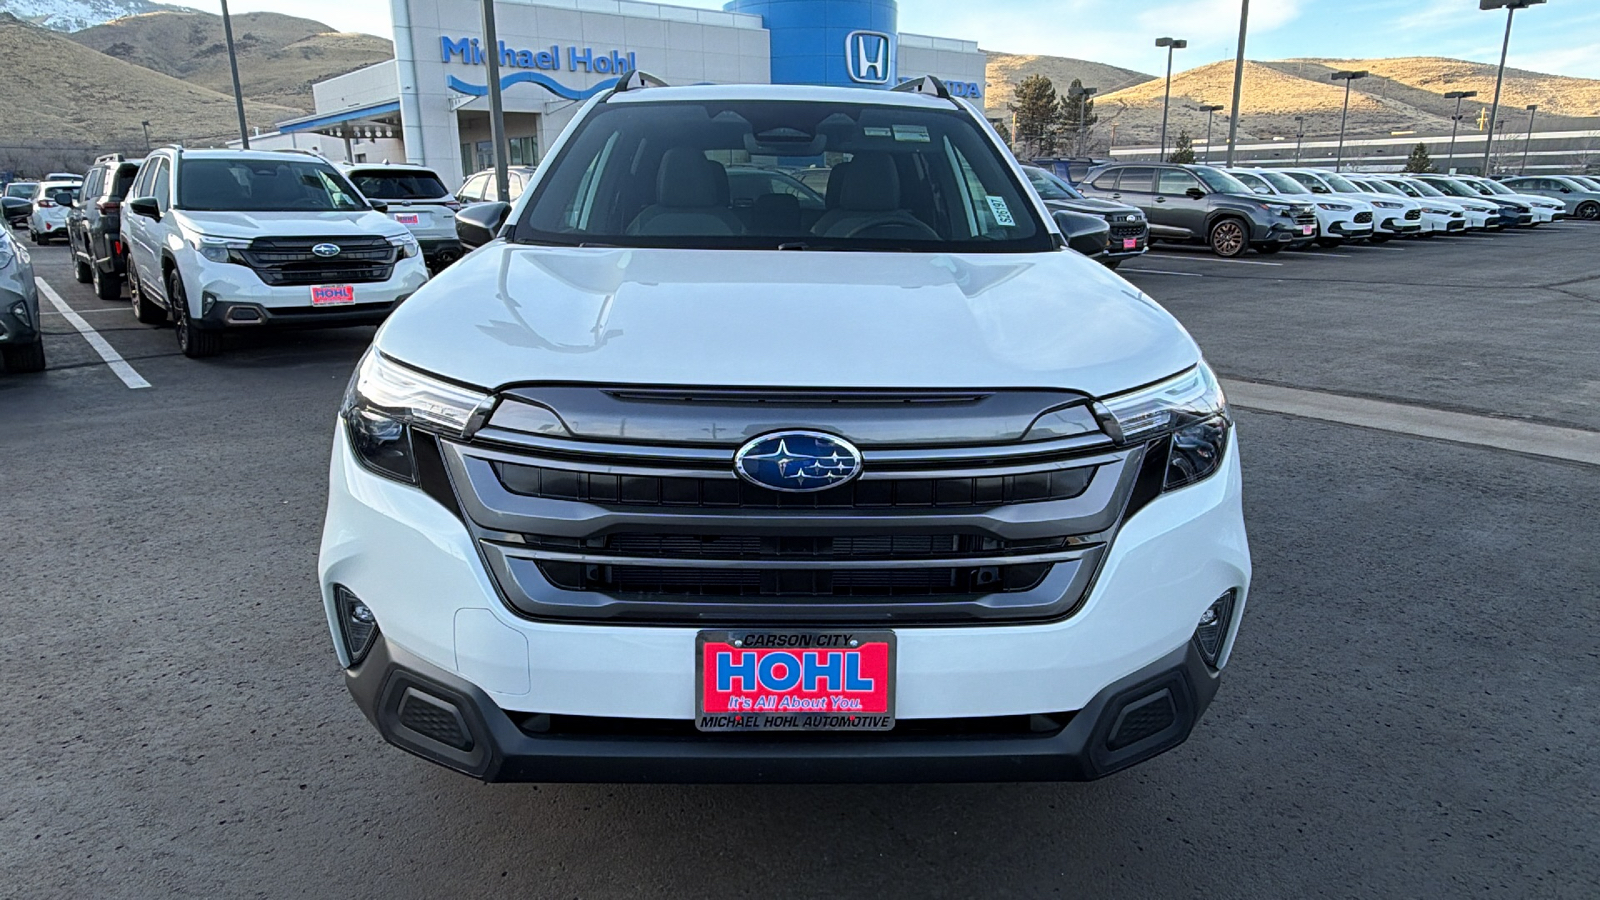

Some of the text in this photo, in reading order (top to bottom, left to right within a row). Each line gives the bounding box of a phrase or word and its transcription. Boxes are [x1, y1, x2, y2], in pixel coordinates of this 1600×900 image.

[567, 46, 636, 75] Hohl
[315, 288, 349, 298] HOHL
[744, 634, 853, 647] CARSON CITY
[716, 651, 874, 692] HOHL
[728, 695, 863, 709] It's All About You.
[700, 716, 890, 728] MICHAEL HOHL AUTOMOTIVE
